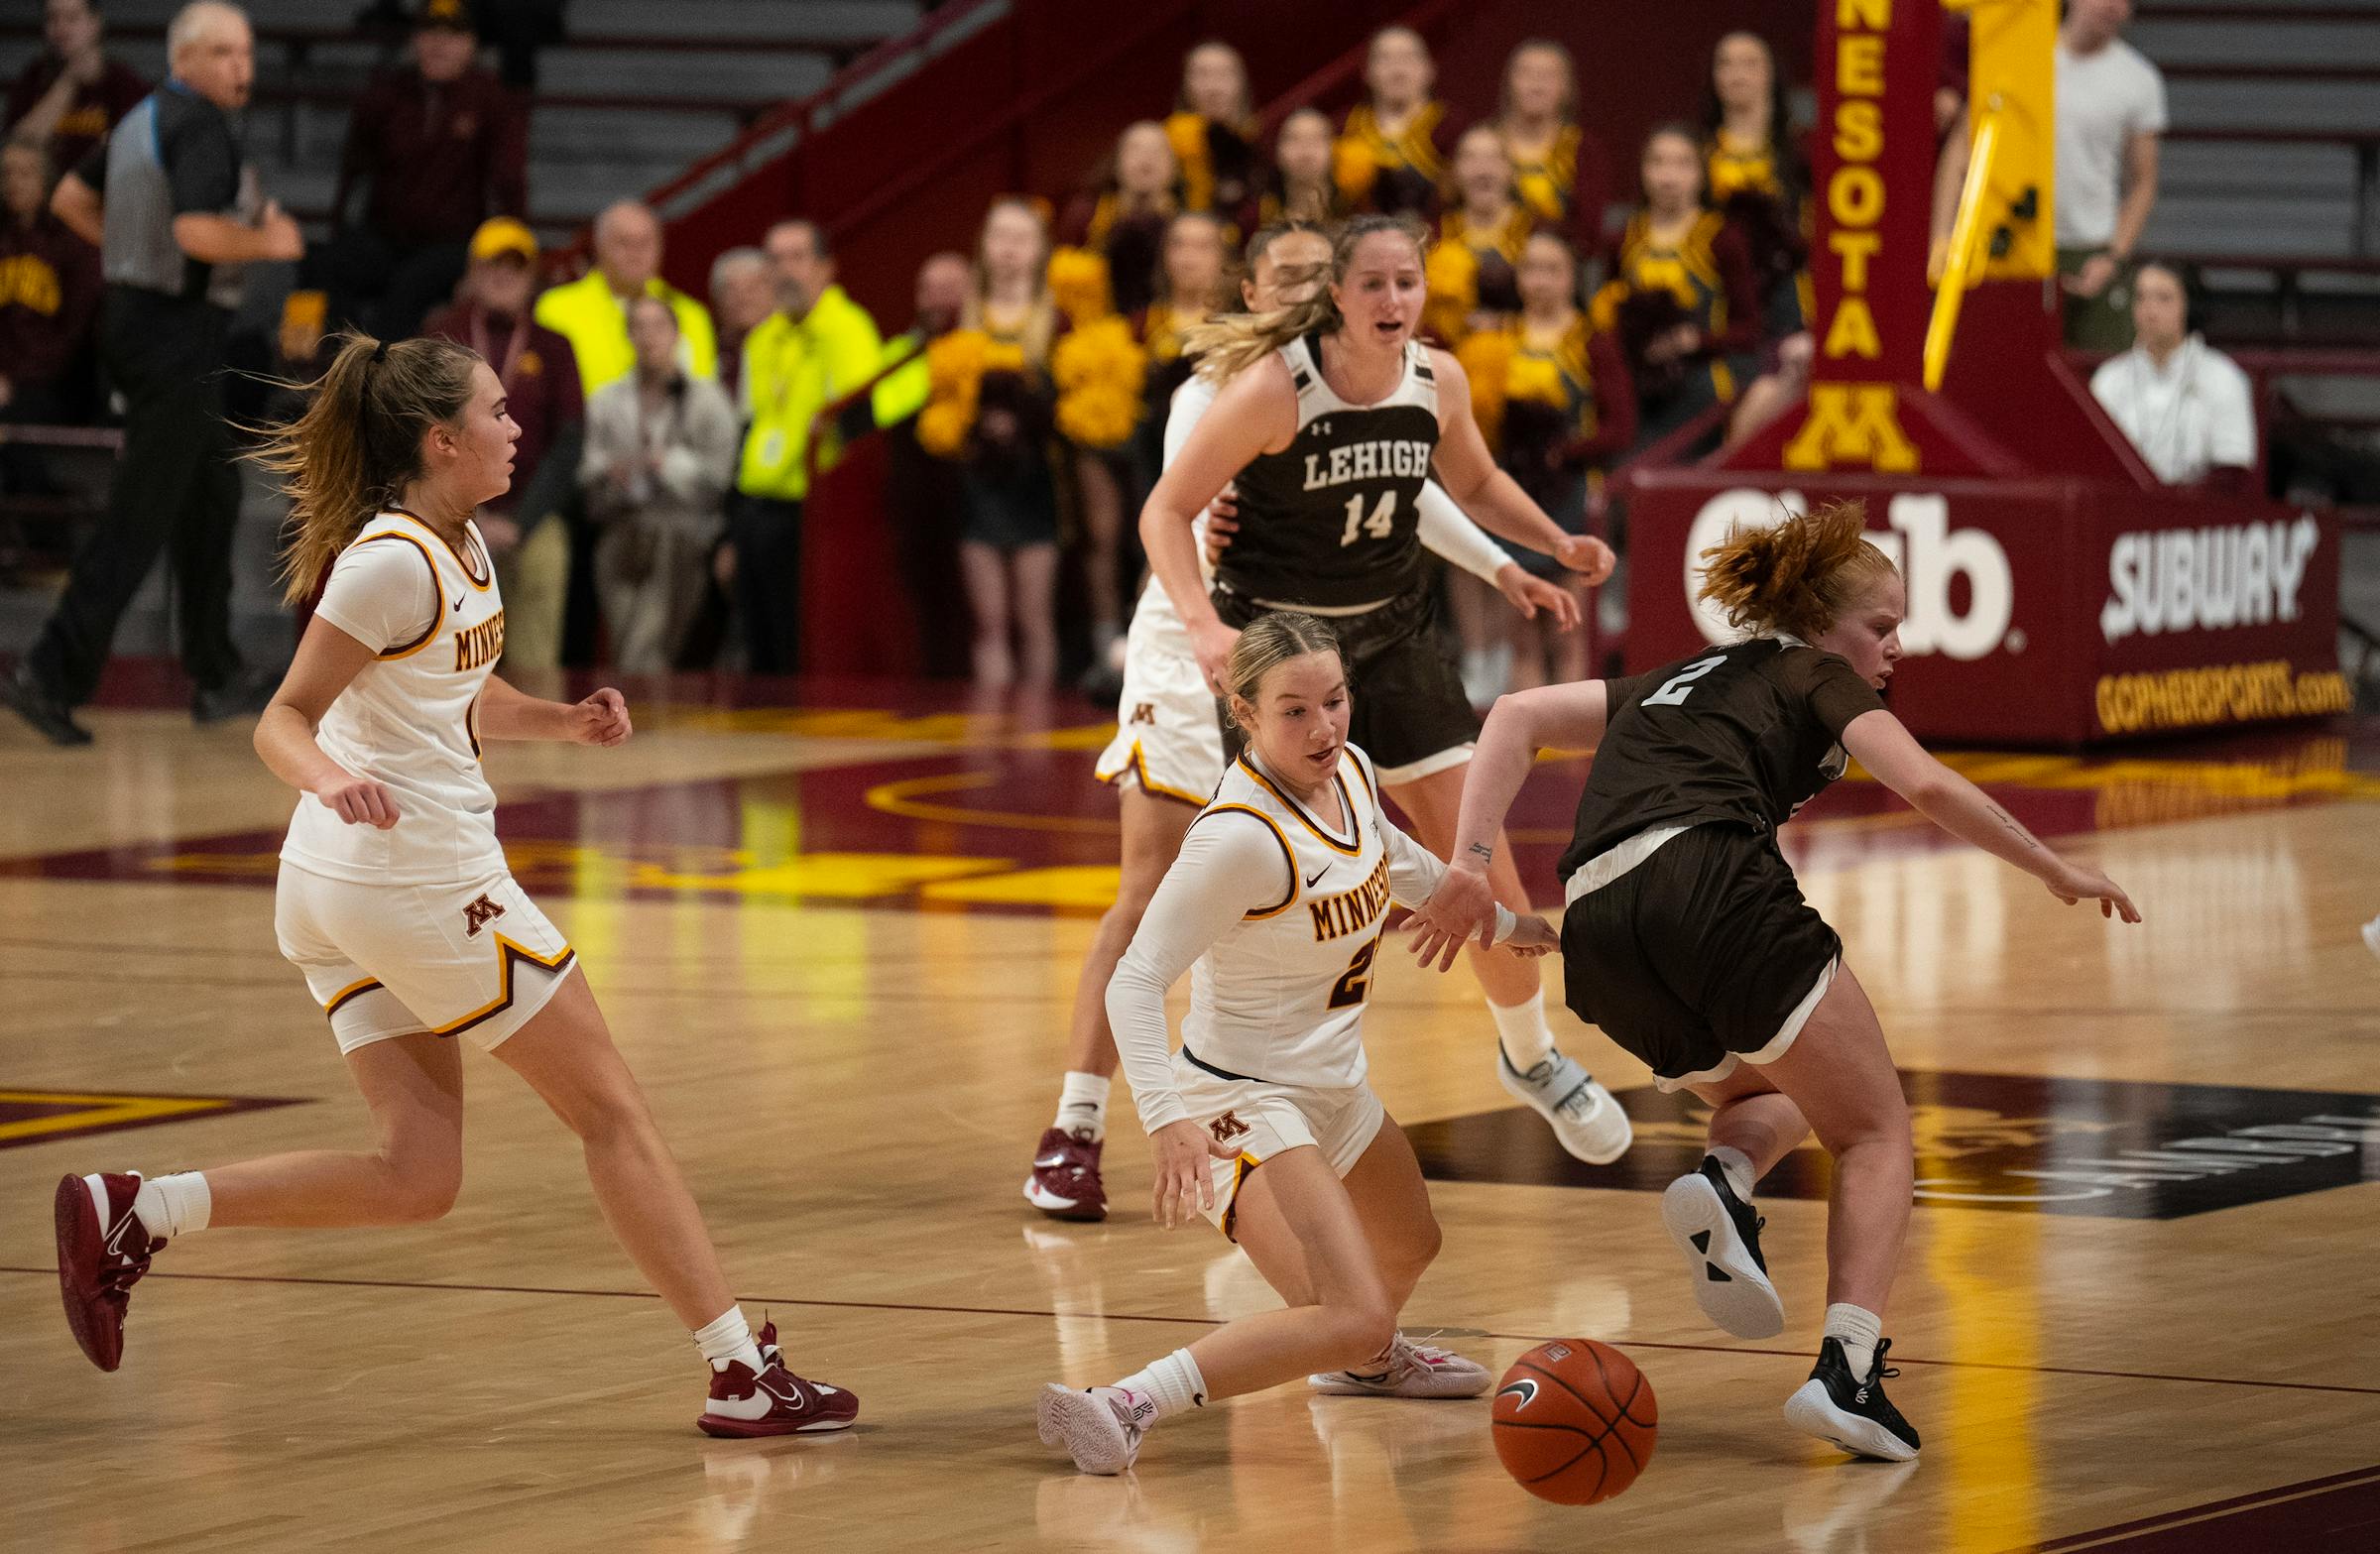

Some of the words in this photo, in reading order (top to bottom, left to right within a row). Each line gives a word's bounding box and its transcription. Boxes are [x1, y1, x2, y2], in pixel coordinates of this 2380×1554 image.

[1782, 381, 1921, 473] M
[1303, 439, 1431, 492] LEHIGH
[1340, 490, 1397, 548] 14
[1683, 487, 2015, 661] Cb
[2099, 512, 2320, 646] SUBWAY
[1640, 655, 1728, 707] 2
[2095, 660, 2353, 735] GOPHERSPORTS.com
[463, 894, 506, 938] M
[1326, 922, 1386, 1011] 2
